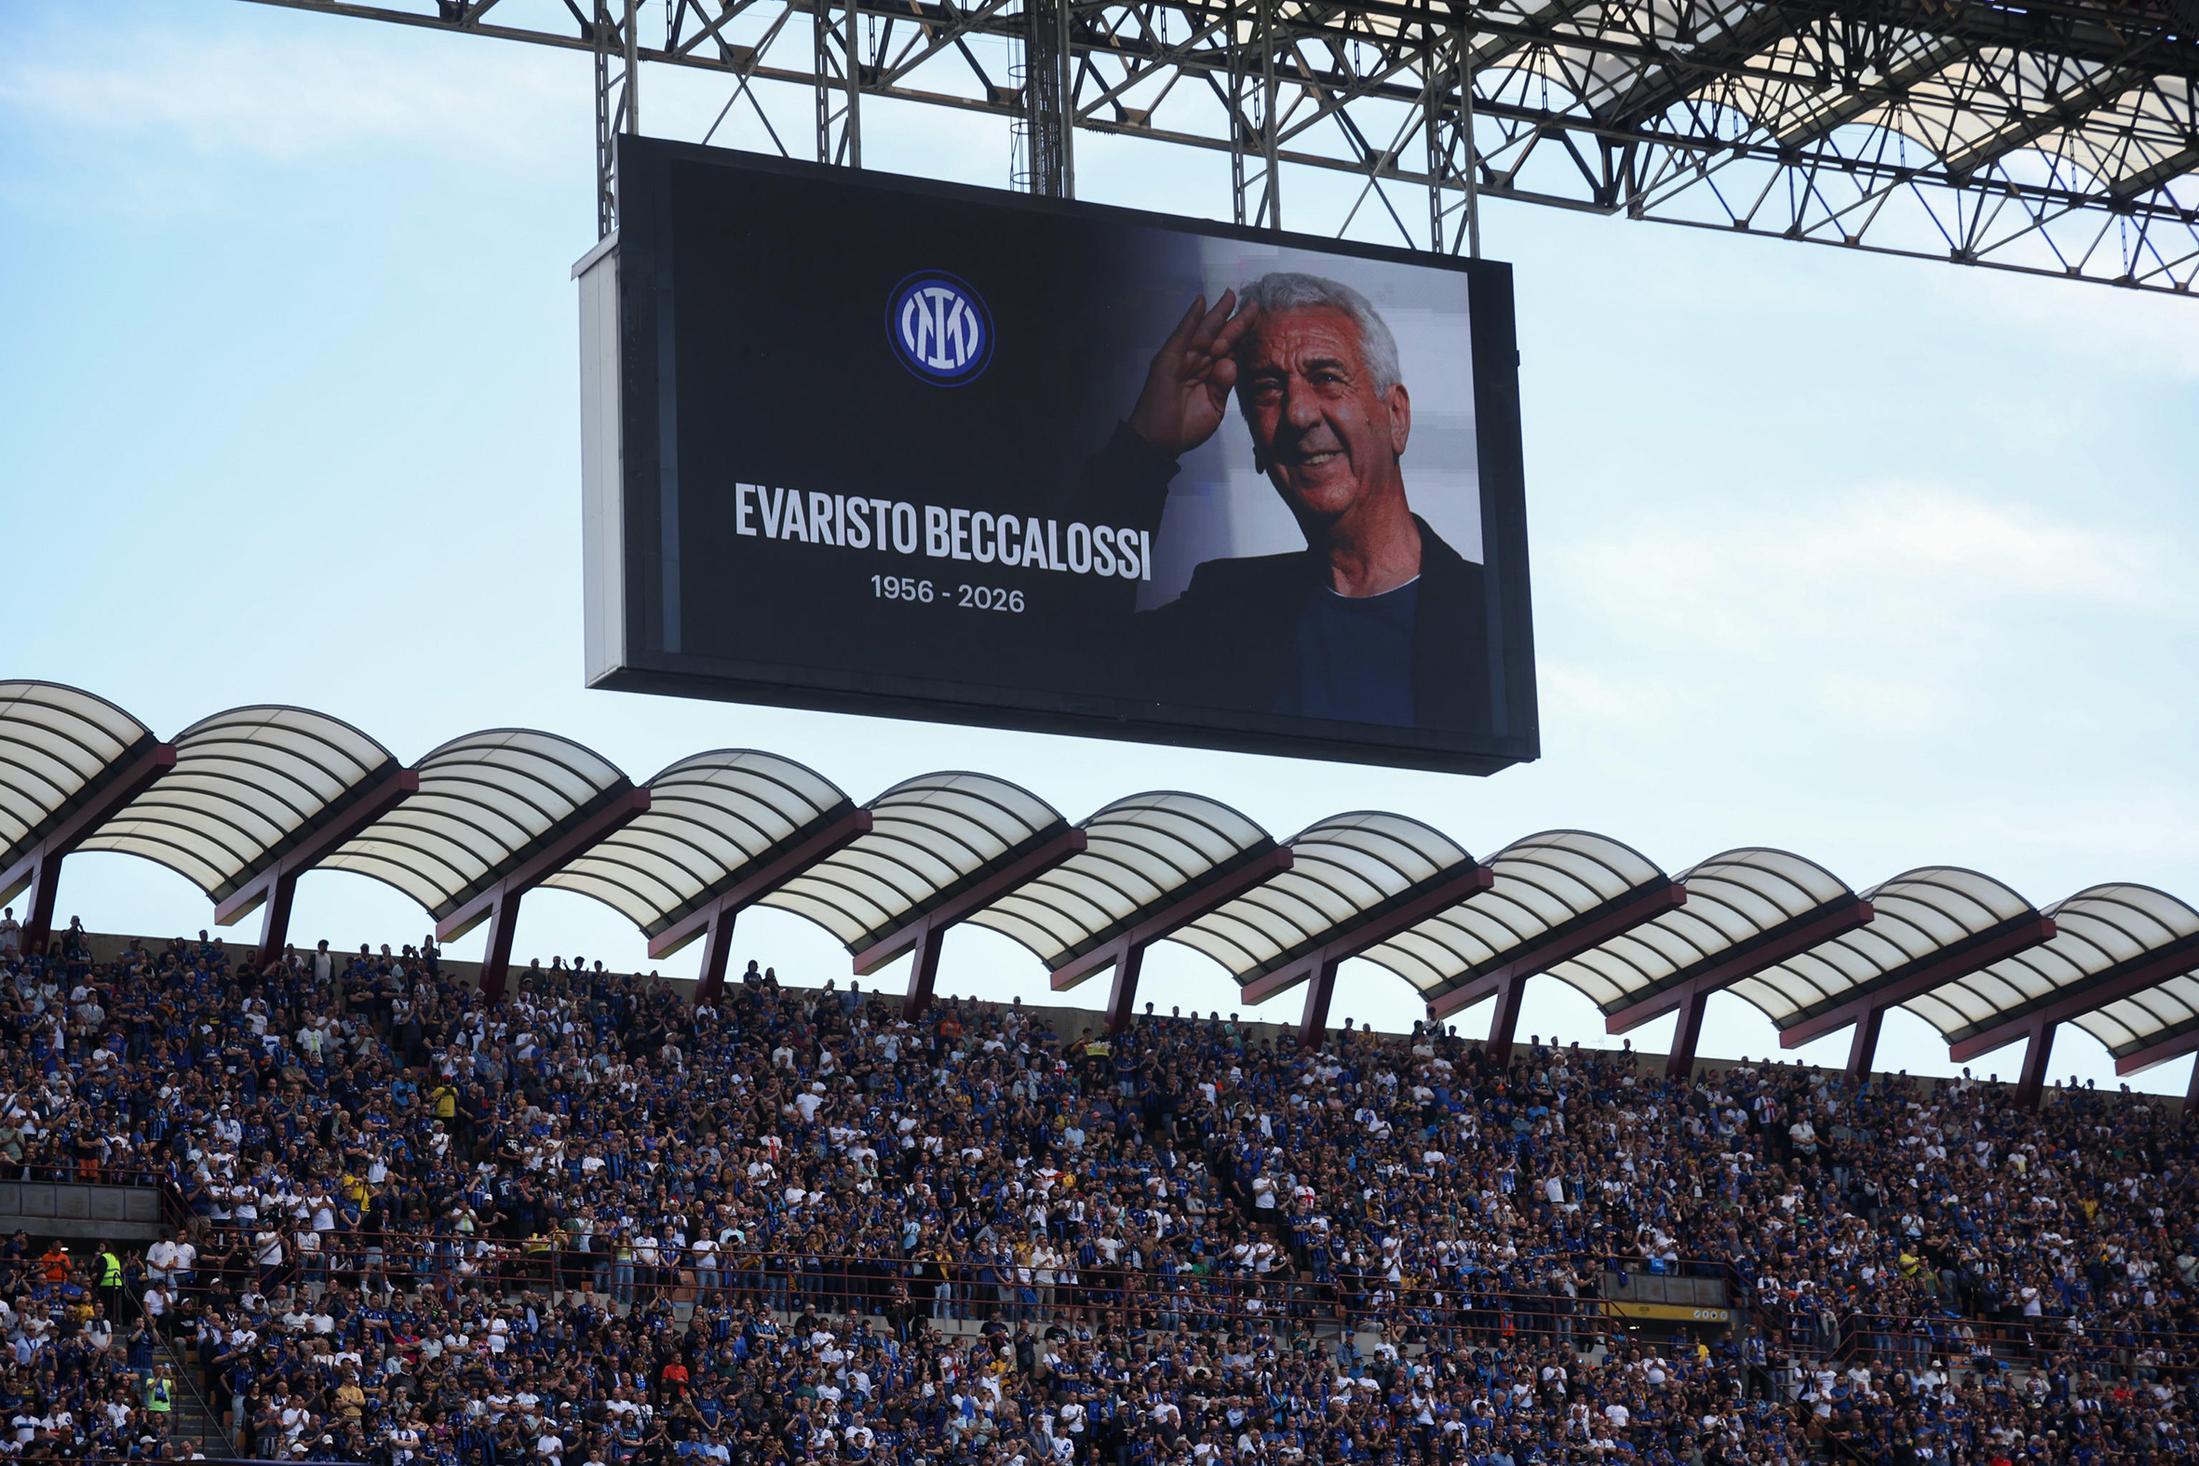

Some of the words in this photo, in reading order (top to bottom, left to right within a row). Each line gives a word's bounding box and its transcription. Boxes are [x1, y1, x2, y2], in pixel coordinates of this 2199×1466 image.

[735, 482, 918, 554] EVARISTO
[924, 505, 1151, 581] BECCALOSSI
[871, 574, 935, 603] 1956
[957, 584, 1026, 613] 2026
